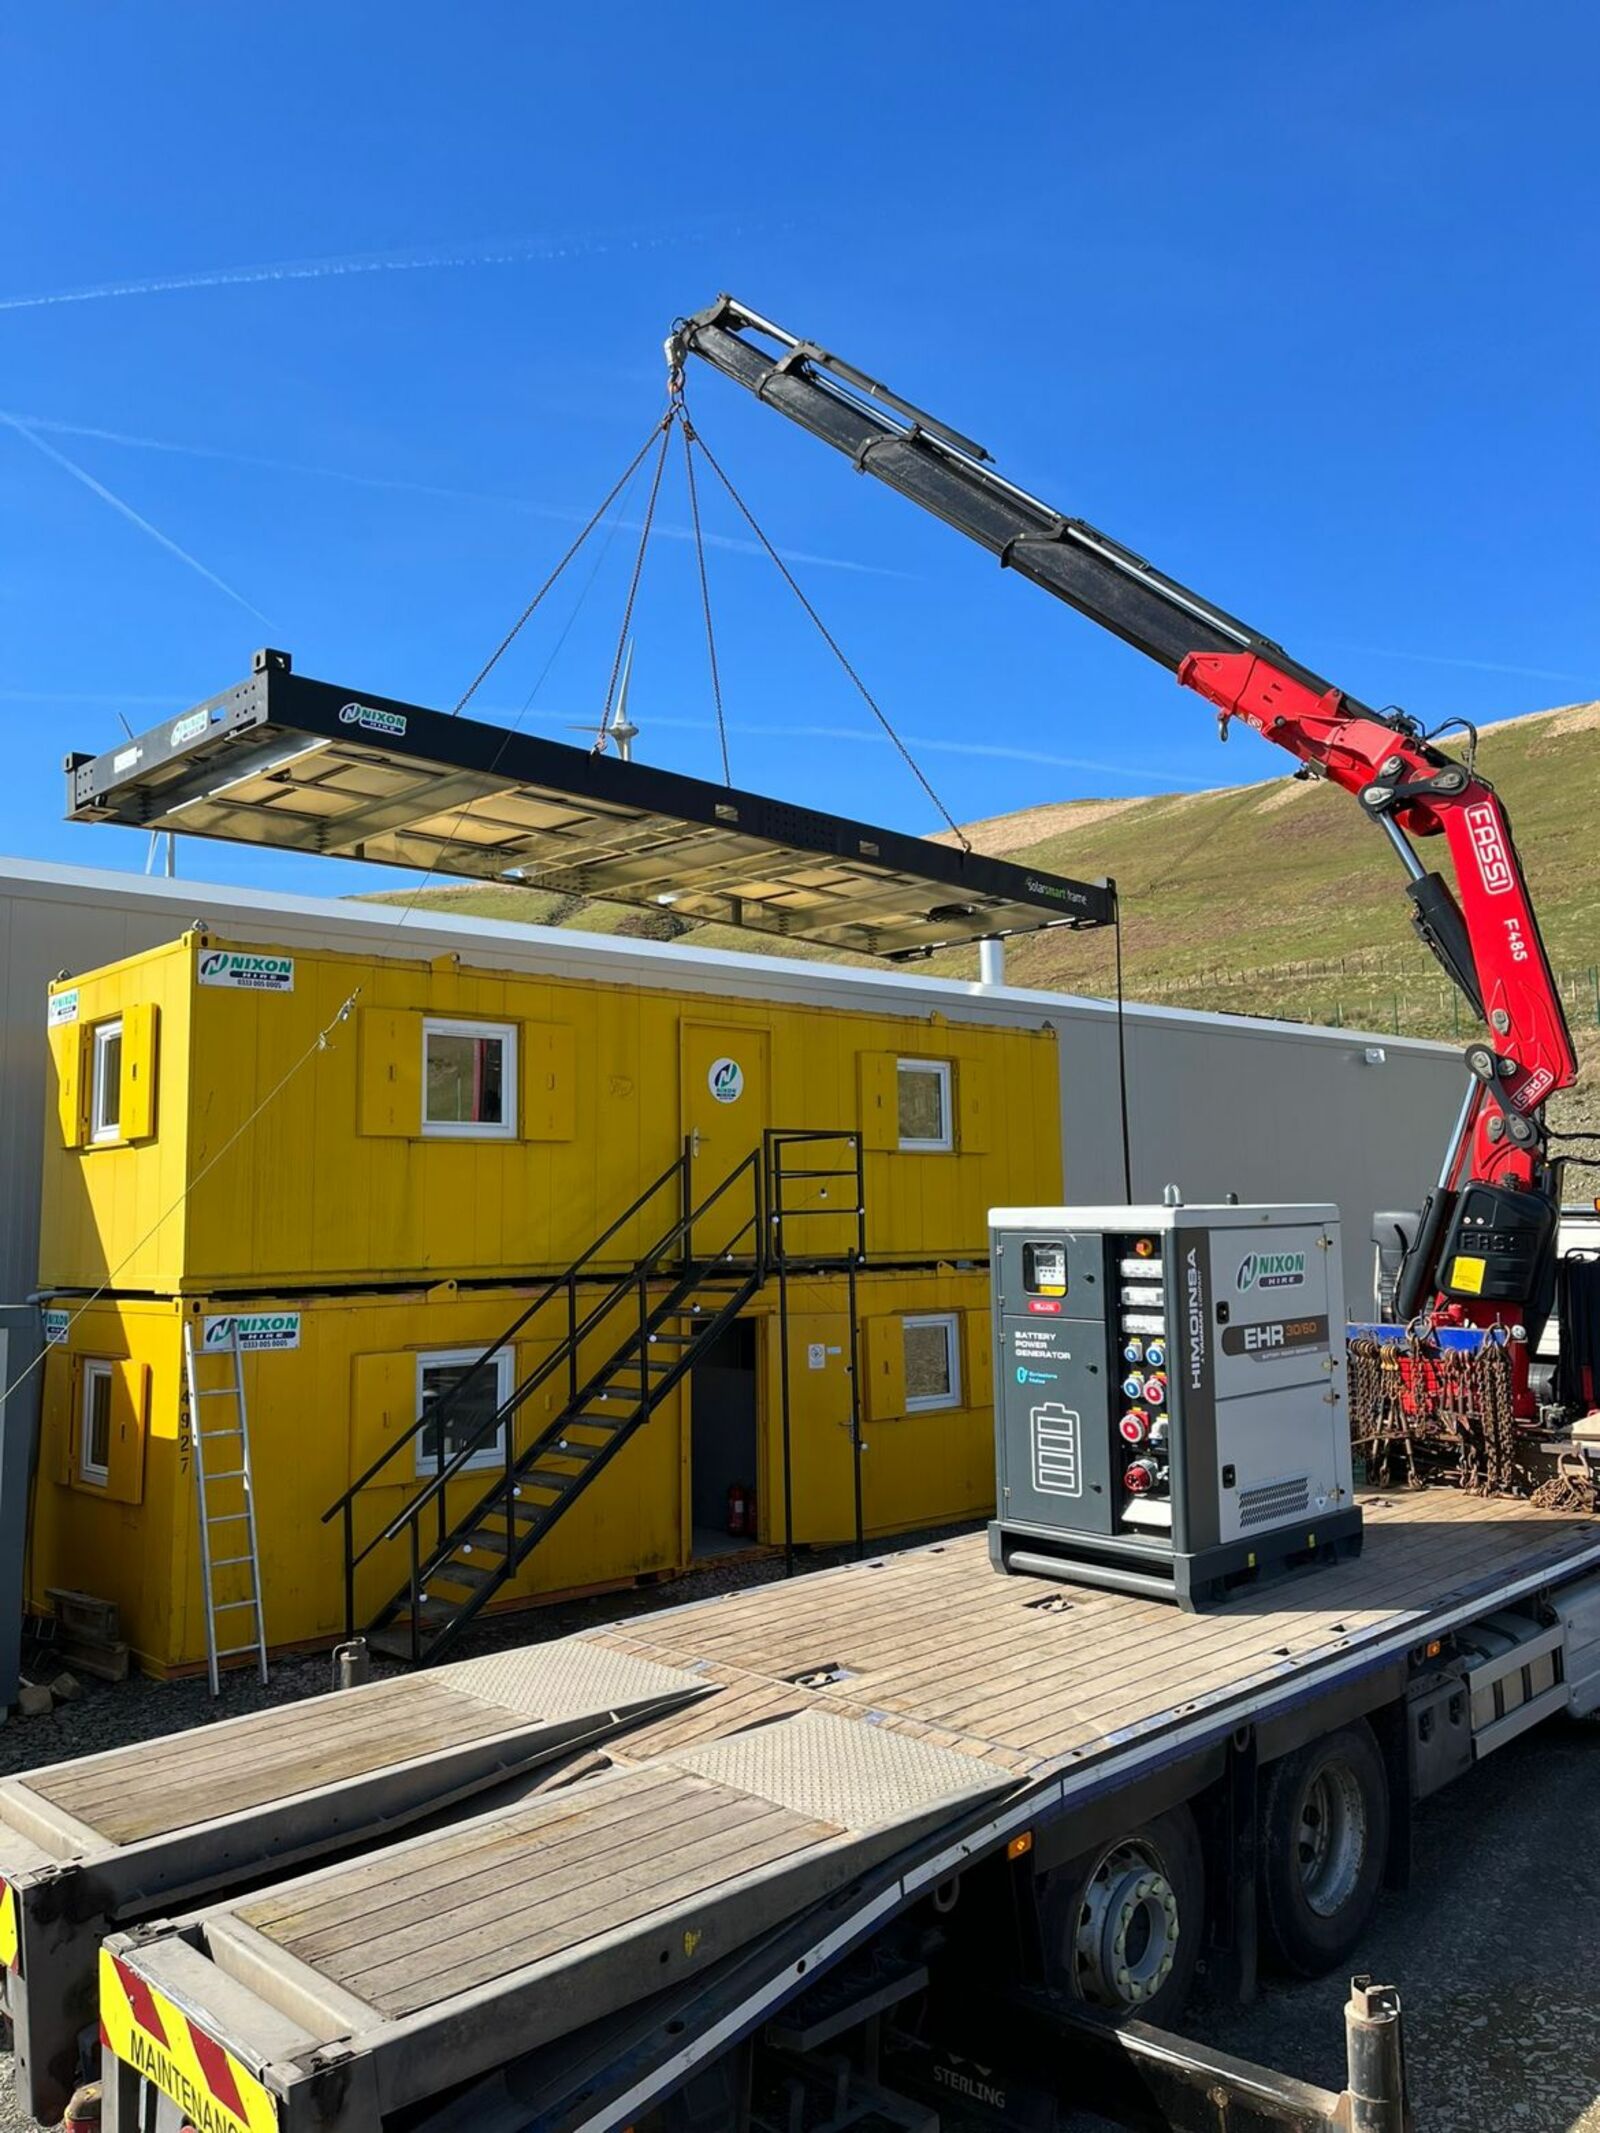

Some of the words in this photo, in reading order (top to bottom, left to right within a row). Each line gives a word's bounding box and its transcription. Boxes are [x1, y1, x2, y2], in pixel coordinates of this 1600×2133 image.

[361, 708, 405, 727] NIXON
[1469, 807, 1509, 888] FASSI
[1503, 917, 1528, 962] F485
[230, 956, 292, 973] NIXON
[1513, 1071, 1550, 1107] FASSI
[1259, 1253, 1304, 1274] NIXON
[1268, 1276, 1295, 1286] HIRE
[238, 1316, 299, 1332] NIXON
[1187, 1247, 1202, 1390] HIMOINSA
[1014, 1330, 1057, 1341] BATTERY
[1014, 1339, 1047, 1349] POWER
[1243, 1324, 1285, 1350] EHR
[1014, 1348, 1071, 1360] GENERATOR
[932, 2064, 1006, 2110] STERLING
